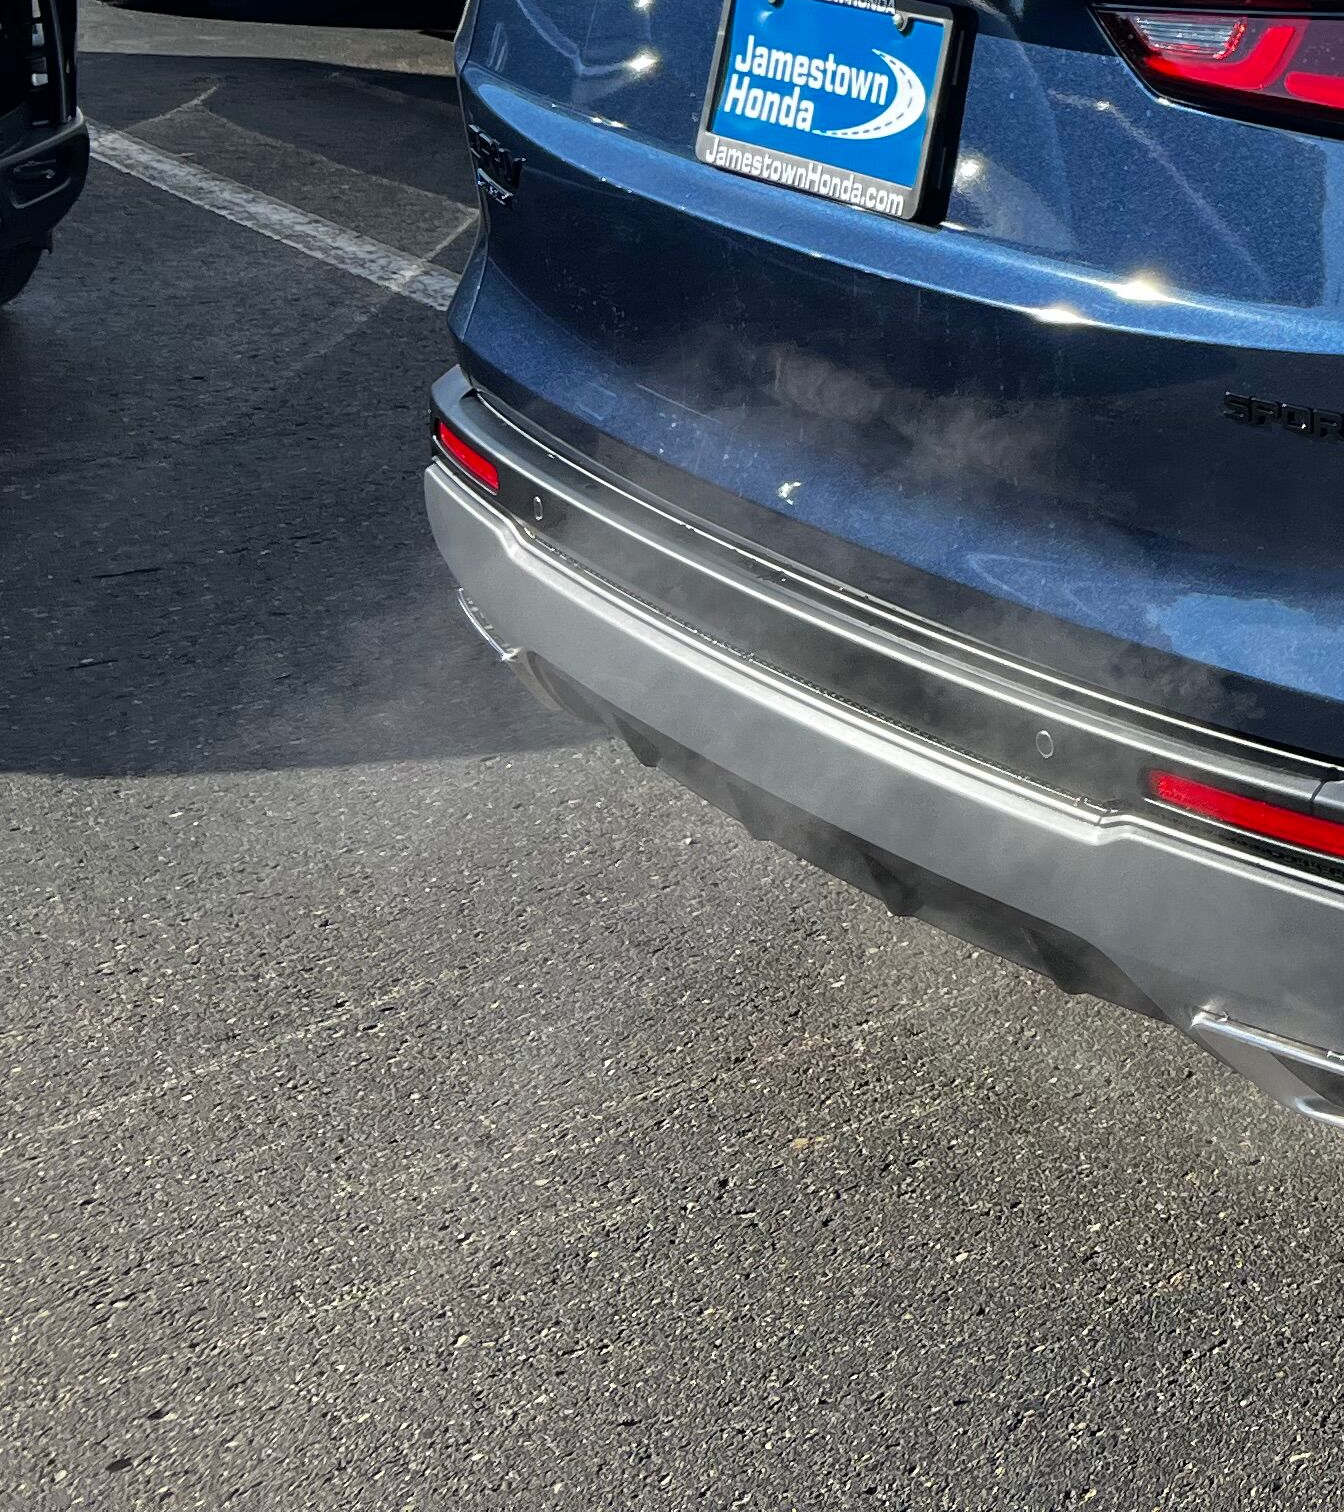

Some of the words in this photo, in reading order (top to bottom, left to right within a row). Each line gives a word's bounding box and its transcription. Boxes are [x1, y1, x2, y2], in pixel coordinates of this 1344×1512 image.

[724, 73, 815, 131] Honda
[735, 35, 889, 106] Jamestown
[705, 138, 904, 216] JamestownHonda.com
